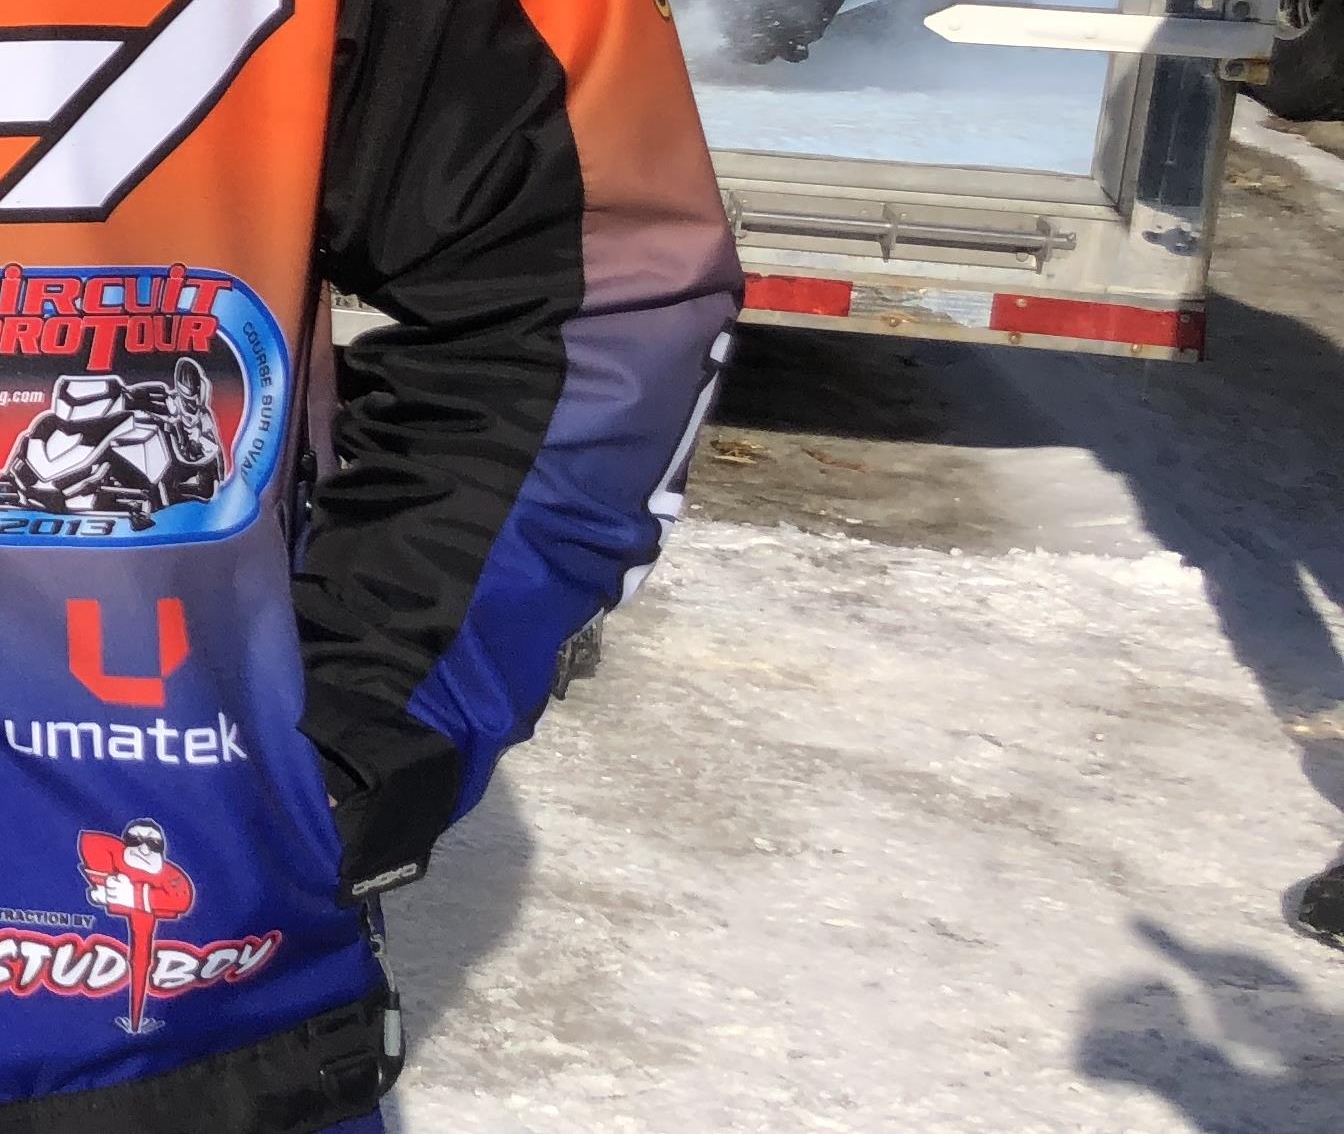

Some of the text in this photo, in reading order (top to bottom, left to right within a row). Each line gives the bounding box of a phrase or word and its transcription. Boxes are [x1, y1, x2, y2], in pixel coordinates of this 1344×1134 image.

[241, 320, 273, 388] COURSE
[259, 394, 273, 432] SUR
[4, 712, 248, 765] umatek
[72, 914, 96, 929] BY
[146, 932, 282, 996] BOY
